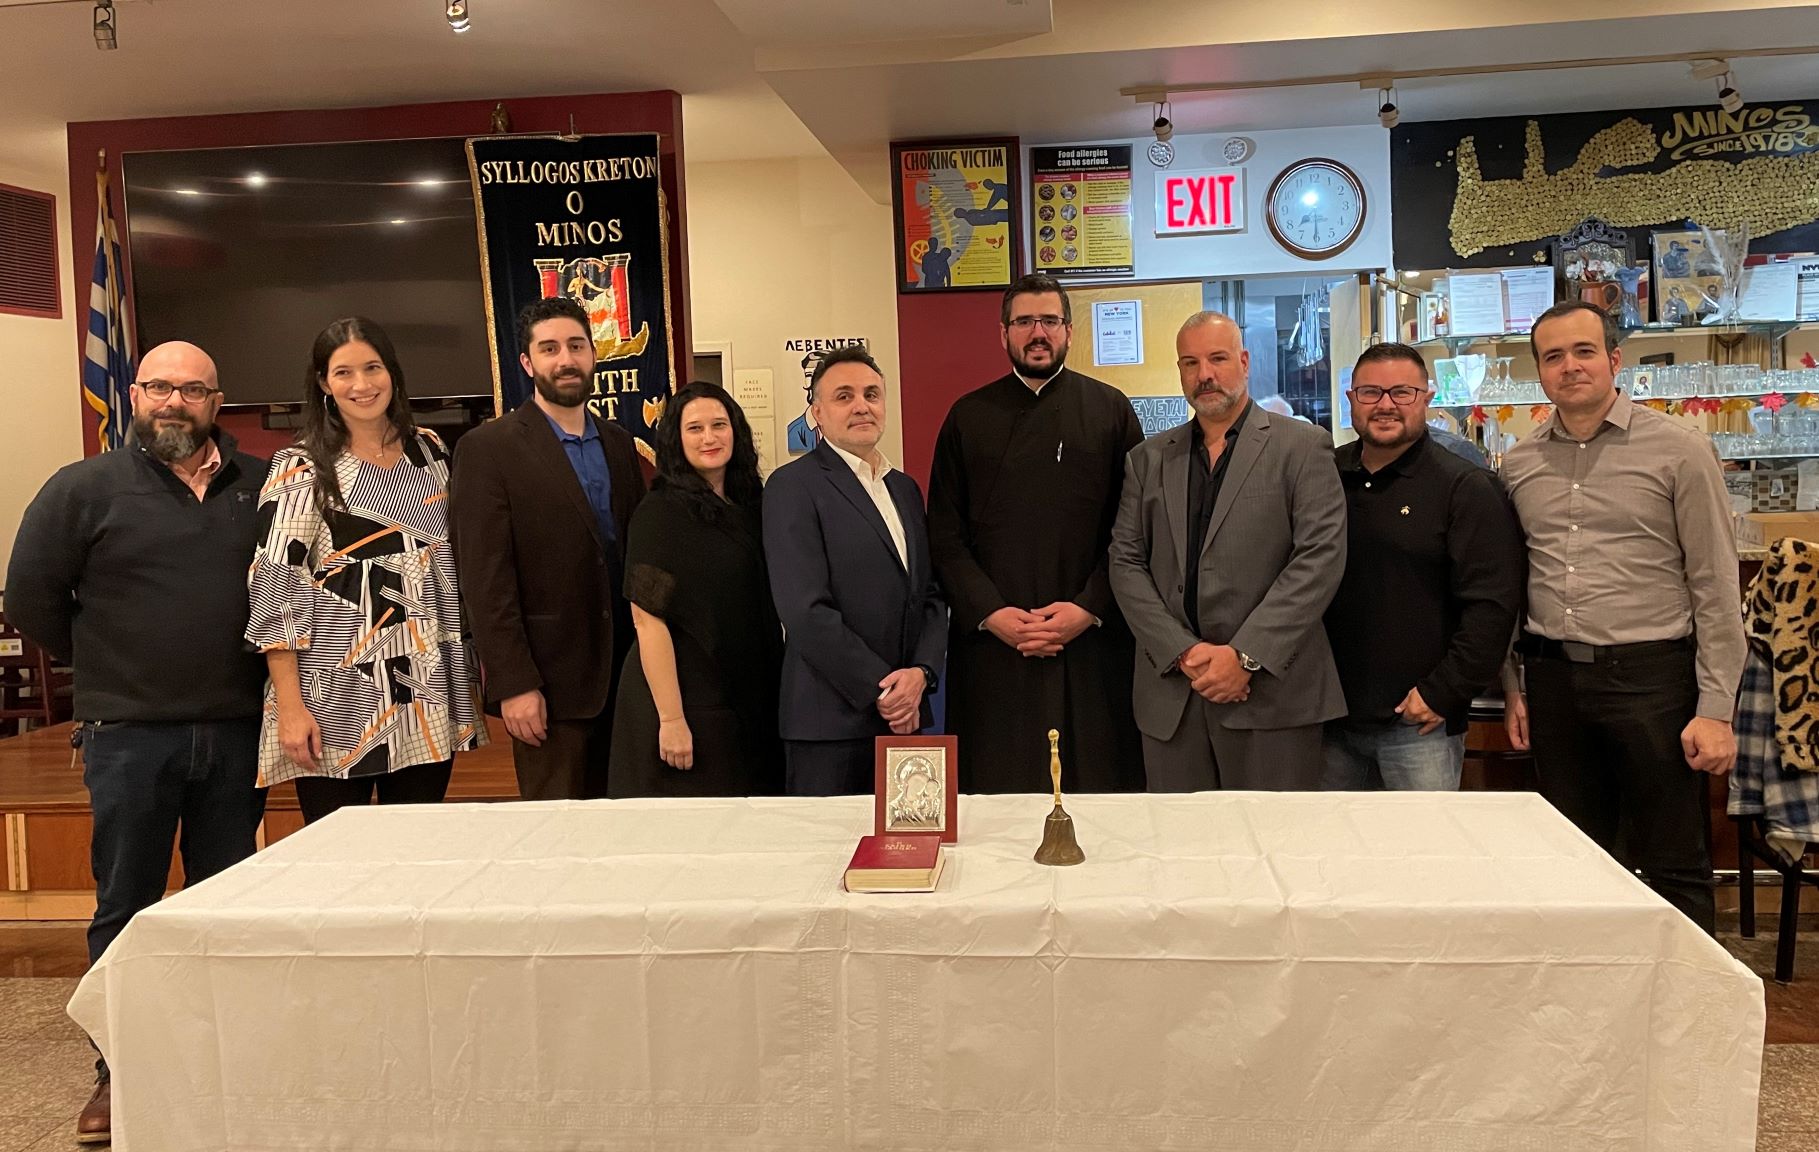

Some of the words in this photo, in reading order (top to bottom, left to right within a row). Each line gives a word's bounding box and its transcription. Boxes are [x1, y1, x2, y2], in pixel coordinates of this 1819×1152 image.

[1662, 106, 1810, 148] MINOS
[1058, 150, 1075, 158] Food
[1076, 149, 1108, 159] allergies
[1693, 140, 1743, 156] SINCE
[1740, 132, 1795, 153] 1978
[481, 161, 581, 185] SYLLOGOS
[583, 156, 657, 183] KRETON
[904, 151, 957, 171] CHOKING
[960, 149, 1004, 168] VICTIM
[1057, 159, 1071, 167] can
[1071, 158, 1081, 166] be
[1082, 157, 1109, 166] serious
[1309, 173, 1320, 183] 12
[1166, 175, 1235, 228] EXIT
[1337, 185, 1344, 196] 2
[566, 191, 584, 215] O
[1342, 200, 1349, 211] 3
[535, 219, 623, 246] MINOS
[1286, 220, 1294, 230] 8
[1328, 228, 1335, 238] 5
[1802, 263, 1819, 272] NY
[590, 369, 640, 395] ITH
[587, 397, 619, 421] ST
